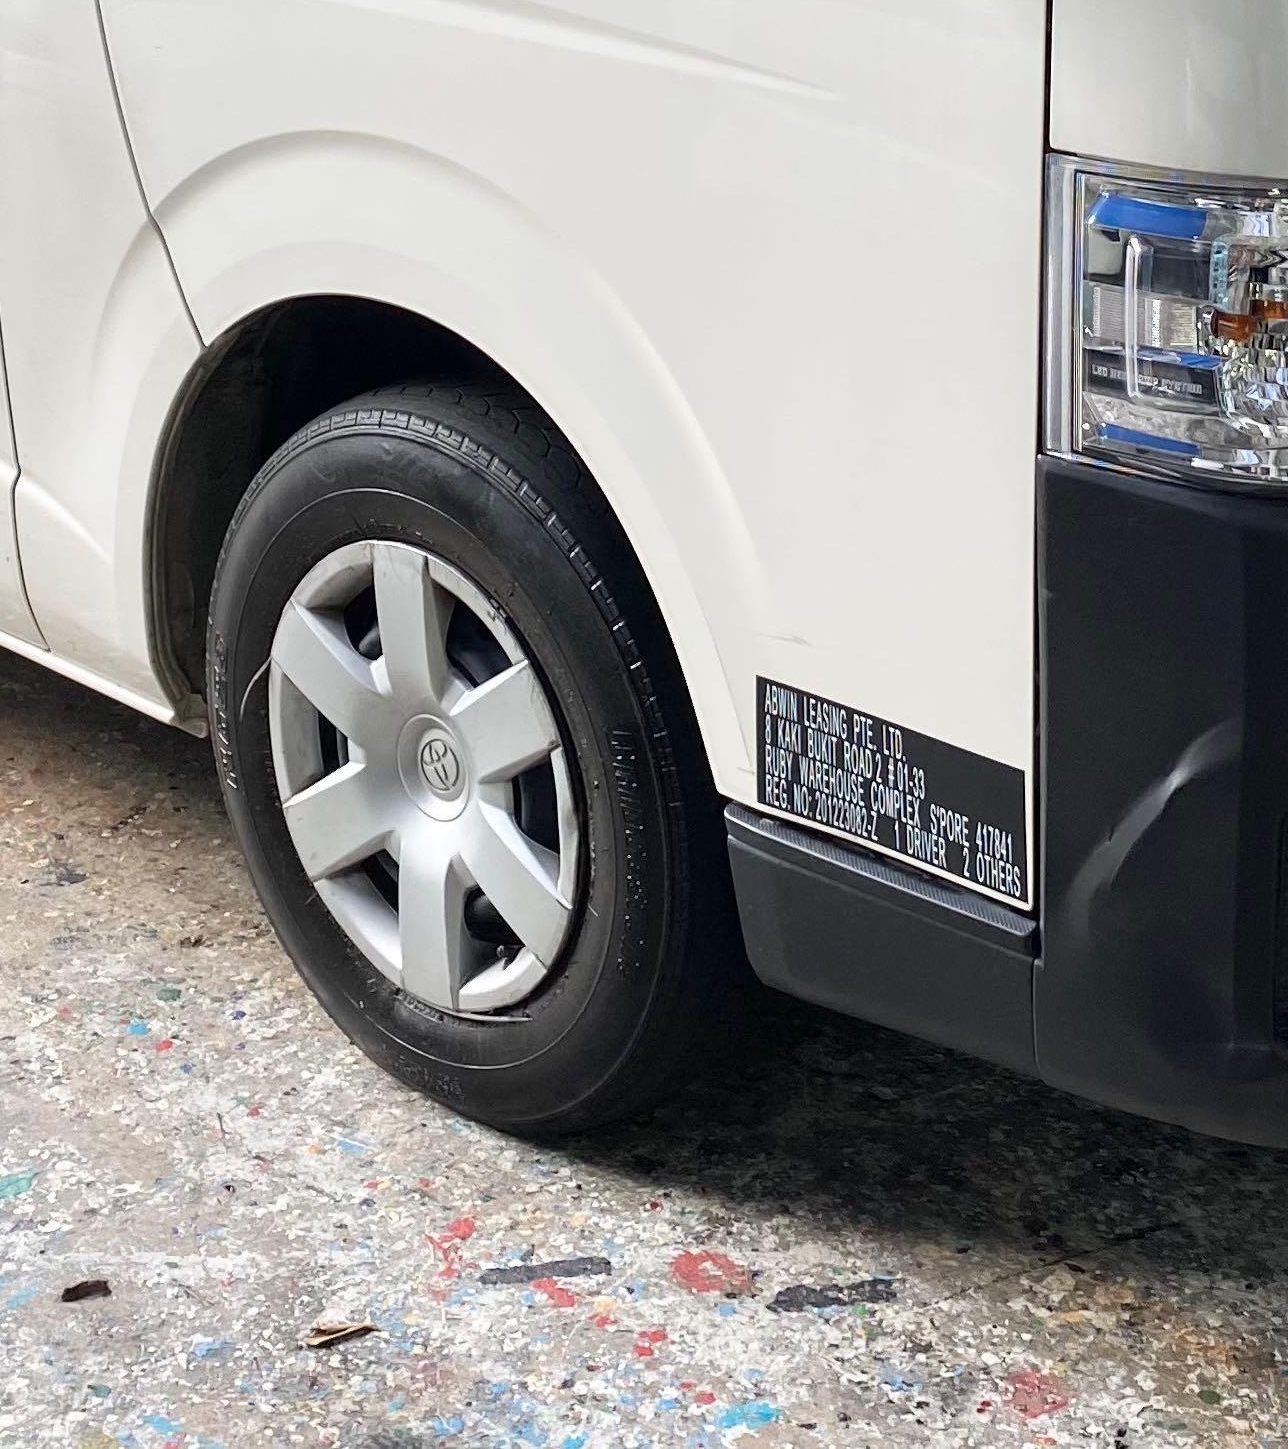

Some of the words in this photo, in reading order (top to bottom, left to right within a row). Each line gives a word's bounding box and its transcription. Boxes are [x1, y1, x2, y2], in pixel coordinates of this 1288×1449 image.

[765, 683, 797, 722] ABWIN
[803, 696, 847, 739] LEASING
[854, 713, 877, 751] PTE.
[883, 724, 906, 761] LTD.
[765, 714, 772, 744] 8
[777, 718, 801, 754] KAKI
[808, 728, 838, 766] BUKIT
[765, 744, 793, 781] RUBY
[799, 755, 865, 807] WAREHOUSE
[870, 781, 920, 829] COMPLEX
[930, 804, 970, 848] S'PORE
[976, 821, 1012, 864] 417841
[815, 791, 879, 841] 201223082-Z
[894, 820, 900, 850] 1
[906, 824, 947, 869] DRIVER
[962, 847, 970, 878] 2
[976, 852, 1022, 898] OTHERS
